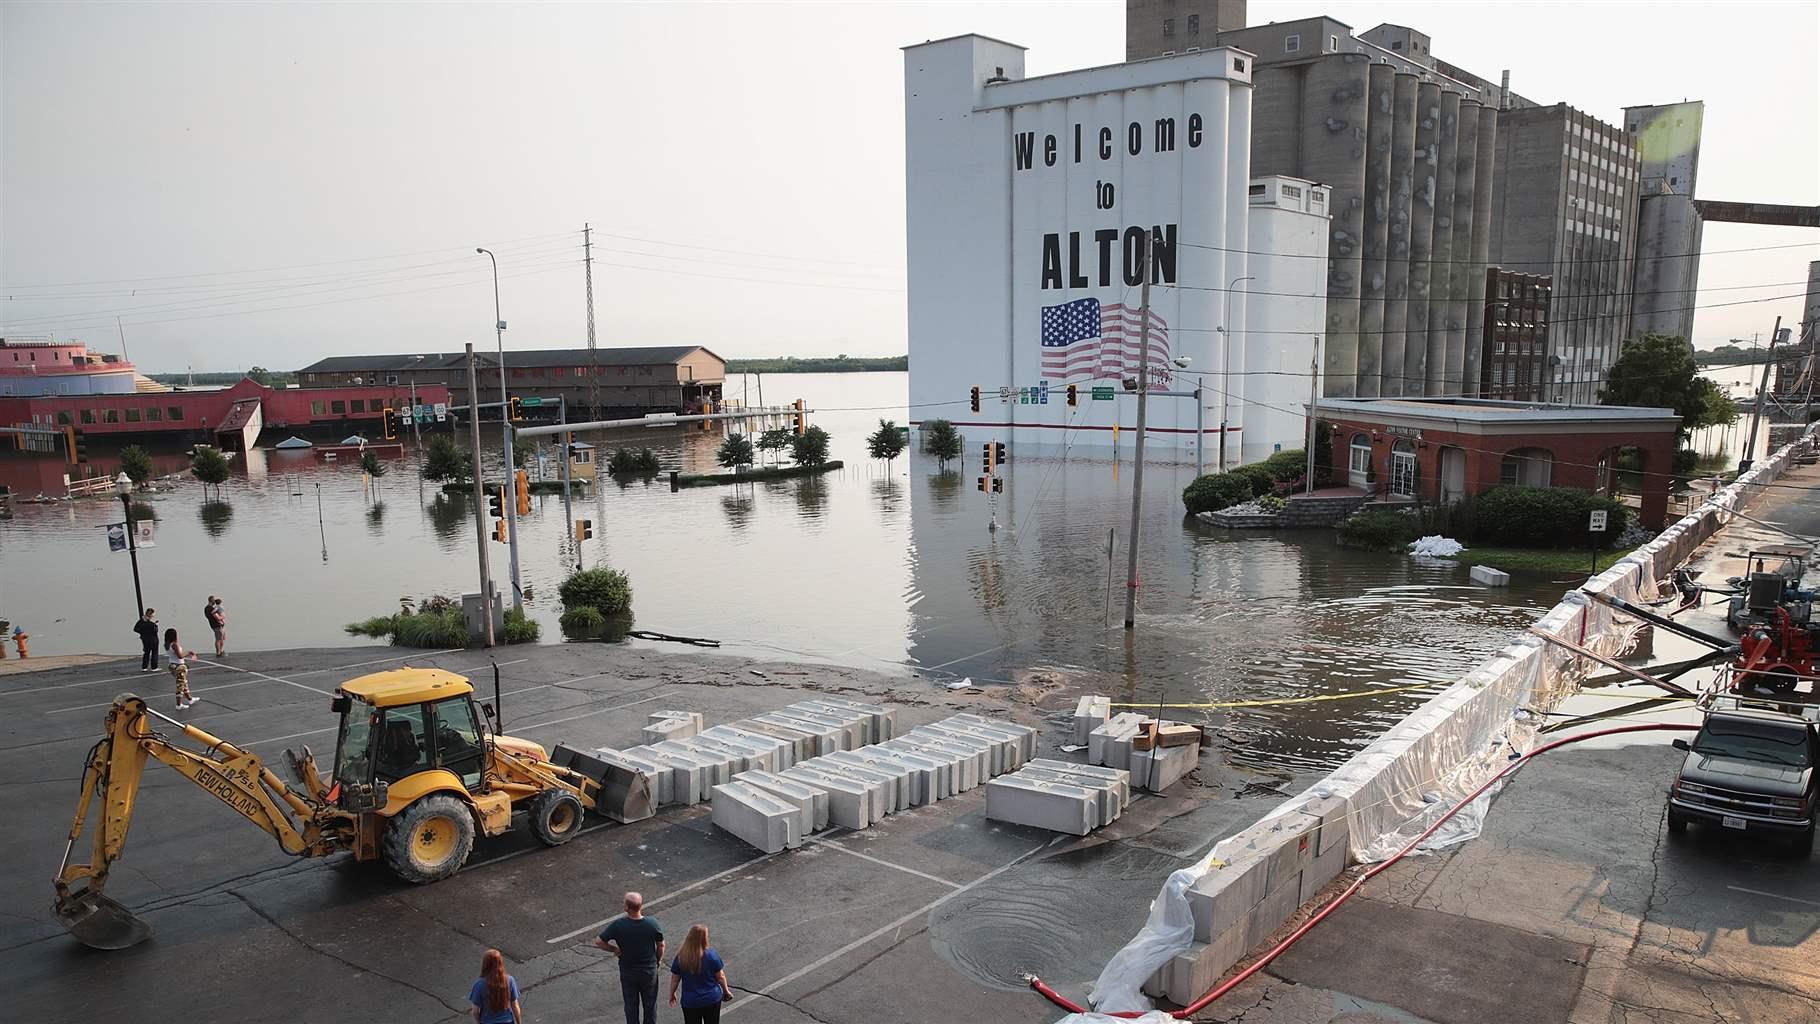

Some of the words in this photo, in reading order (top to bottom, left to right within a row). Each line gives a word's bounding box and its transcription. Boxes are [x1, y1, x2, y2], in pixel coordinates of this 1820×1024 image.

[1015, 113, 1203, 171] Welcome
[1096, 180, 1115, 210] to
[1041, 223, 1178, 290] ALTON
[194, 768, 217, 790] NEW
[215, 783, 257, 817] HOLLAND
